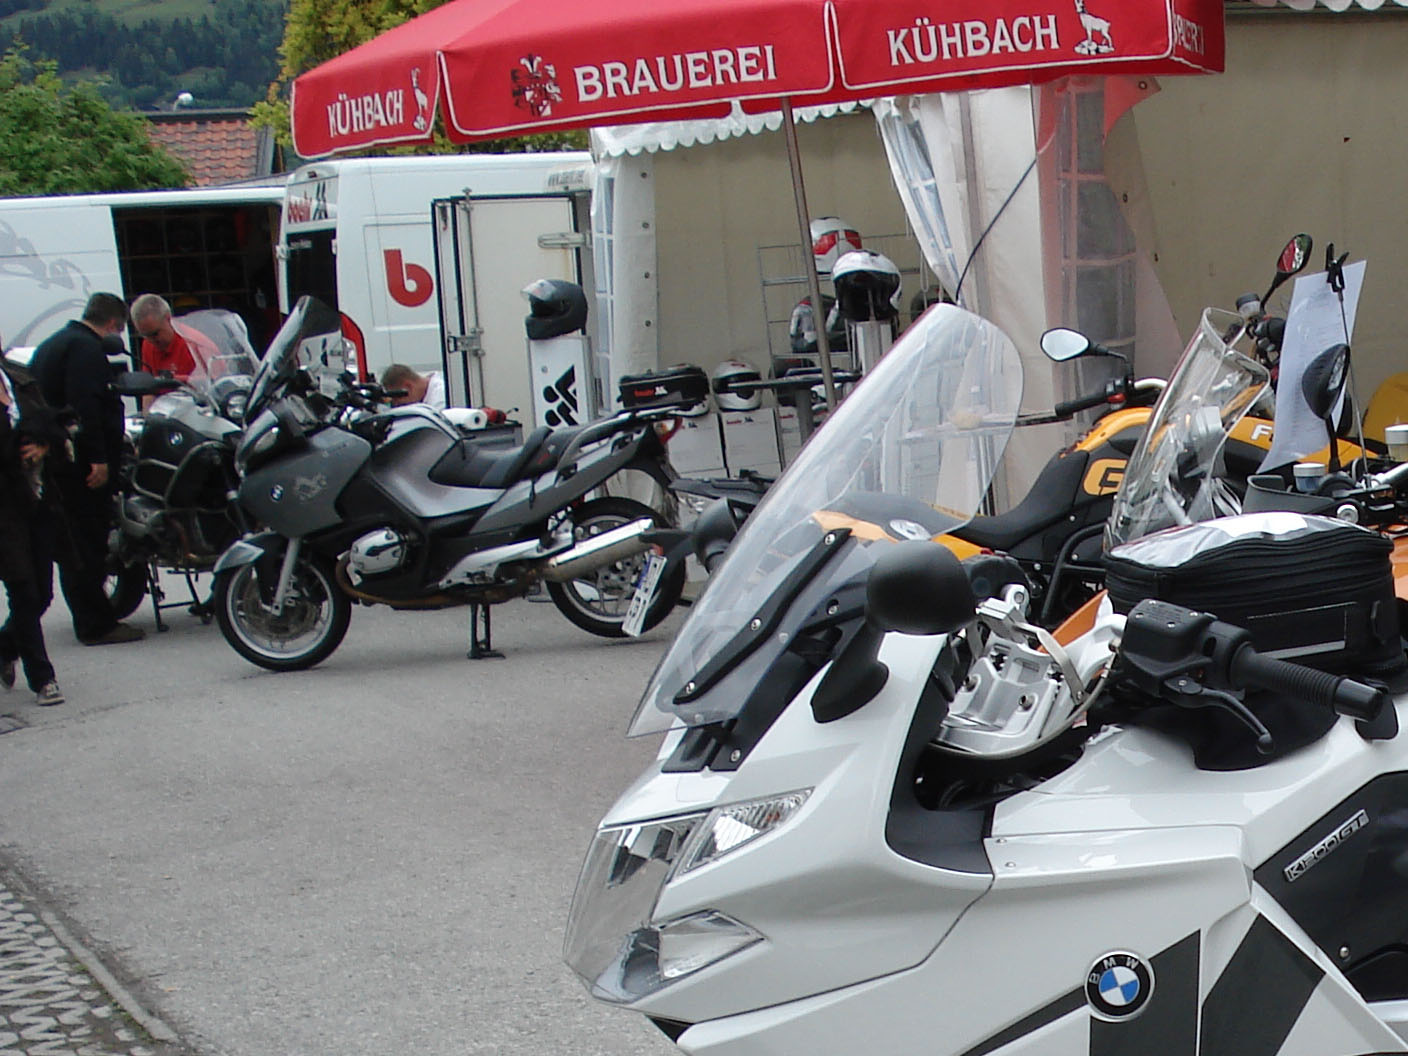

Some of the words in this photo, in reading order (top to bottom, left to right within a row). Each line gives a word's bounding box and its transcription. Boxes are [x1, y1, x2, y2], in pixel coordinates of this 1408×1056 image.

[888, 15, 1060, 66] KÜHBACH
[574, 45, 777, 102] BRAUEREI
[327, 89, 404, 138] KÜHBACH
[1088, 956, 1139, 984] BMW
